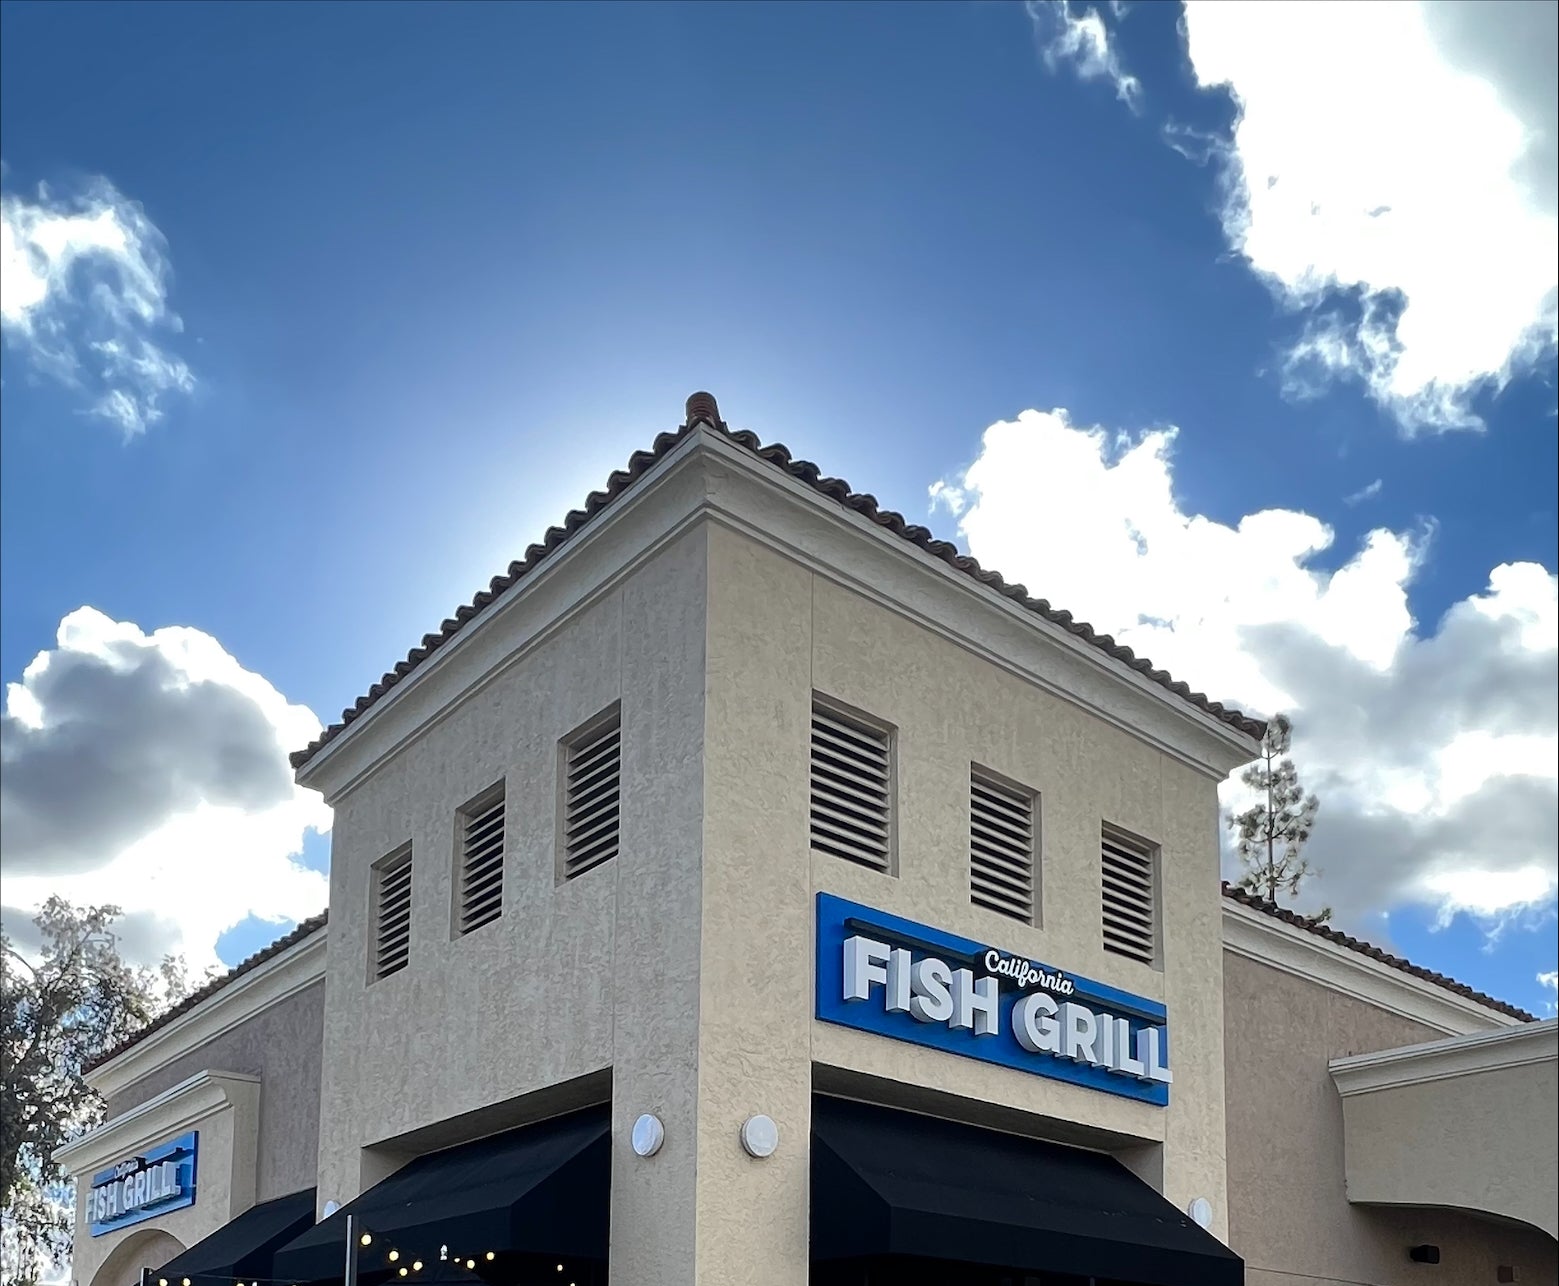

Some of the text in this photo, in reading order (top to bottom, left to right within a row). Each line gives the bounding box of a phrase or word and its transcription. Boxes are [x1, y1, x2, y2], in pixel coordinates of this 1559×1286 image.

[984, 950, 1075, 998] California
[843, 935, 1173, 1084] FISH GRILL
[85, 1181, 123, 1223] FISH
[123, 1161, 181, 1210] GRILL
